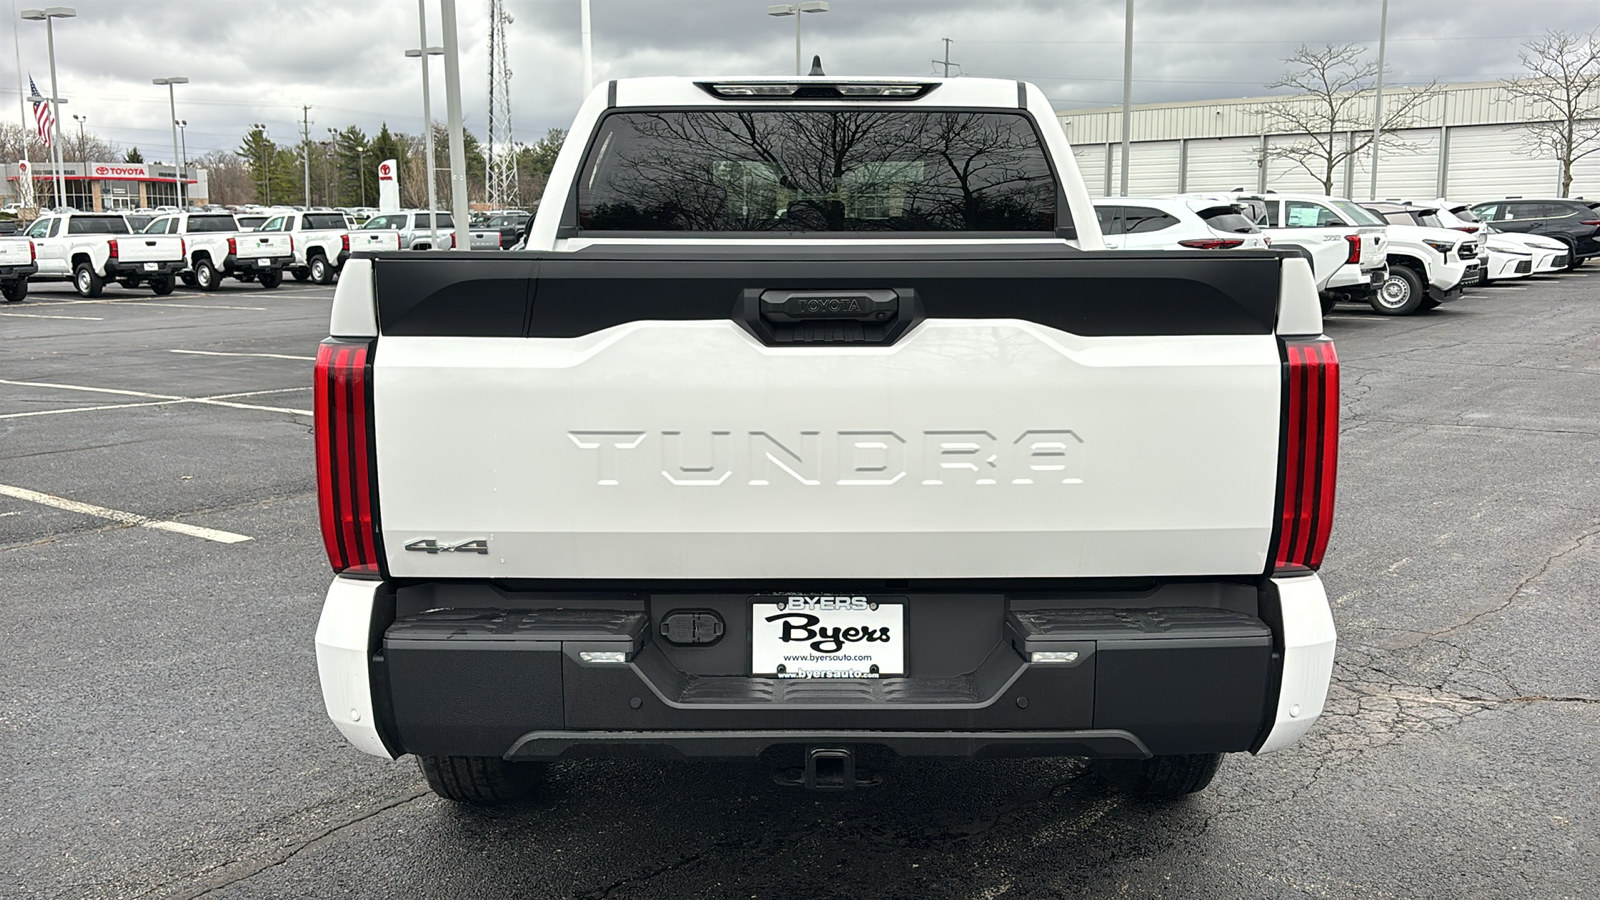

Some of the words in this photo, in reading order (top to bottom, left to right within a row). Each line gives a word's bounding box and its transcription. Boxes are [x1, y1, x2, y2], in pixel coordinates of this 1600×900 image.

[798, 299, 860, 312] TOYOTA
[567, 430, 1084, 486] TUNDRA
[788, 596, 868, 611] BYERS
[764, 612, 891, 653] Byers
[783, 653, 872, 663] www.byersauto.com
[777, 668, 879, 679] www.byersauto.com
